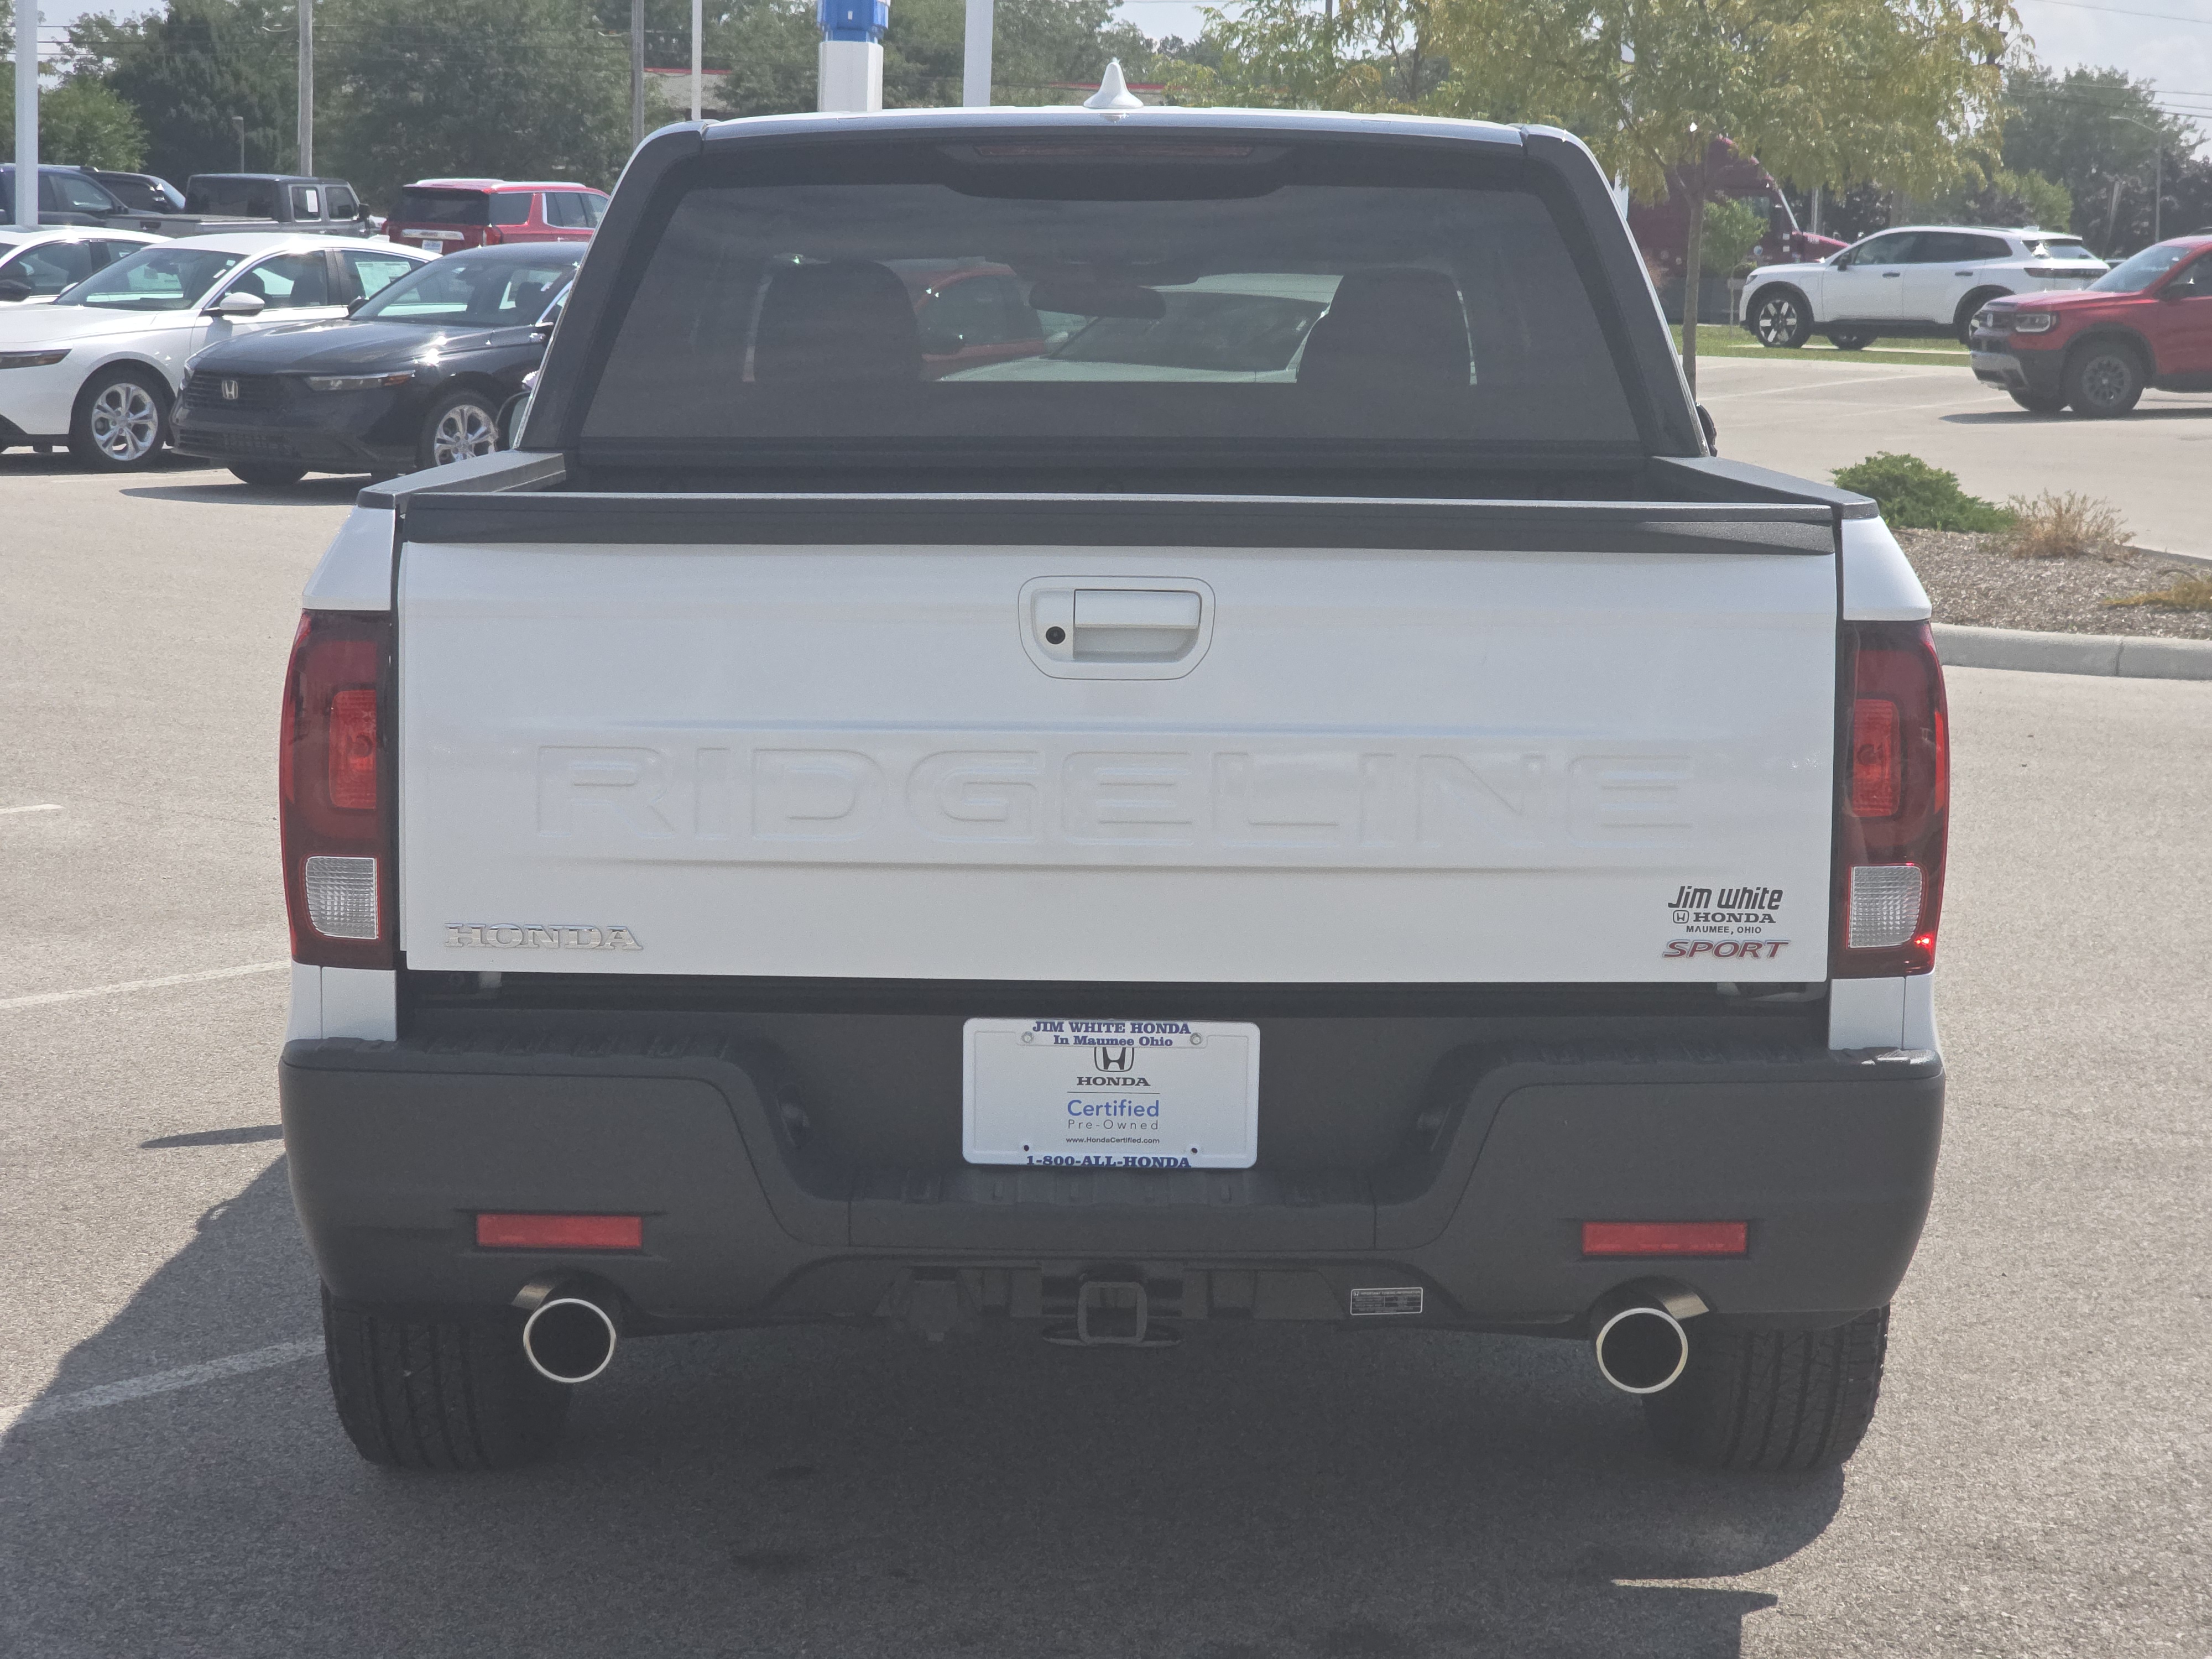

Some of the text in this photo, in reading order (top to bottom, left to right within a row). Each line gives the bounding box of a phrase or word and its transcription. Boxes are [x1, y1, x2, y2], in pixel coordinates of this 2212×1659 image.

[537, 746, 1694, 848] RIDGELINE
[1668, 886, 1712, 909] Jim
[1693, 912, 1776, 923] HONDA
[444, 923, 643, 950] HONDA
[1686, 925, 1734, 935] MAUMEE,
[1662, 939, 1791, 959] SPORT
[1032, 1021, 1191, 1034] JIM WHITE HONDA
[1053, 1035, 1173, 1046] In Maumee Ohio
[1077, 1077, 1151, 1086] HONDA
[1067, 1099, 1159, 1117] Certified
[1068, 1119, 1159, 1130] Pre-Owned
[1027, 1155, 1191, 1168] 1-800-ALL-HONDA
